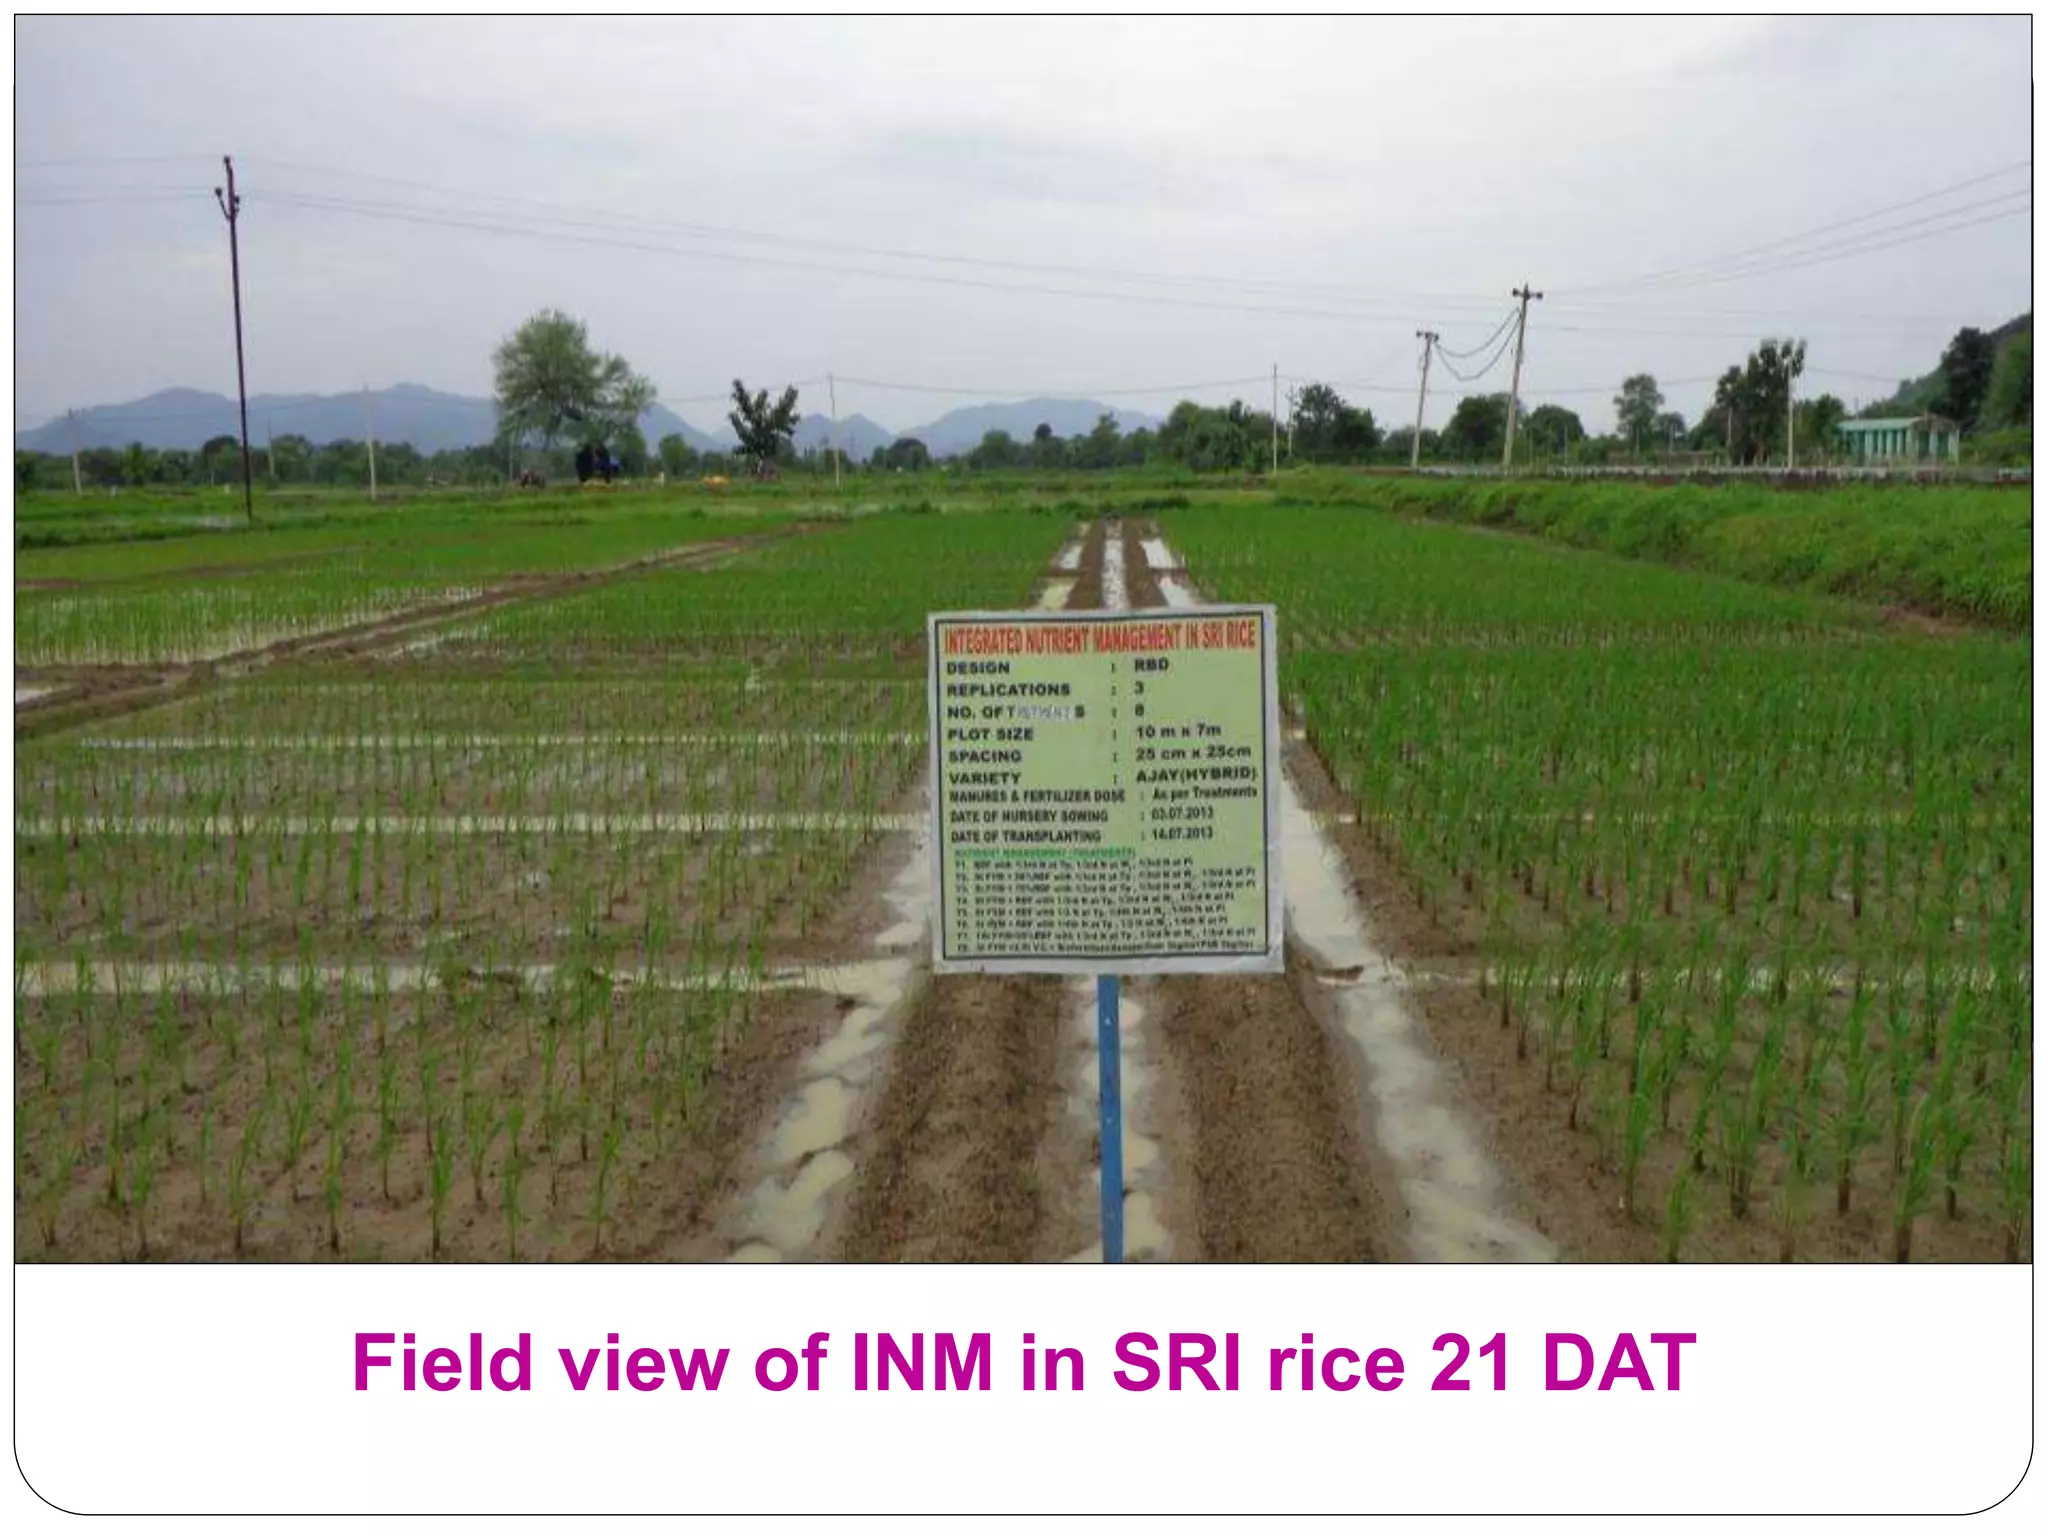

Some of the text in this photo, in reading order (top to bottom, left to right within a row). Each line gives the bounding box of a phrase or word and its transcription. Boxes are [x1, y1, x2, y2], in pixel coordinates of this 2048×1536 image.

[945, 619, 1256, 655] INTEGRATED NUTRIENT MANAGEMENT IN SRI RICE
[947, 661, 1010, 675] DESIGN
[1134, 657, 1170, 672] RBD
[947, 683, 1071, 697] REPLICATIONS
[1135, 681, 1144, 694] 3
[947, 705, 976, 719] NO.
[982, 705, 1004, 718] OF
[1135, 703, 1144, 717] 8
[947, 727, 990, 741] PLOT
[996, 727, 1034, 741] SIZE
[1136, 725, 1155, 739] 10
[1161, 727, 1176, 738] m
[1197, 723, 1222, 737] 7m
[948, 749, 1022, 762] SPACING
[1136, 748, 1155, 762] 25
[1161, 749, 1186, 760] cm
[1192, 748, 1200, 758] x
[1207, 745, 1251, 759] 25cm
[949, 772, 1021, 784] VARIETY
[1136, 766, 1256, 784] AJAY(HYBRID)
[949, 789, 1007, 802] MANURES
[1011, 790, 1019, 802] &
[1023, 789, 1091, 802] FERTILIZER
[1094, 789, 1126, 803] DOSE
[1153, 788, 1167, 800] As
[1171, 789, 1189, 802] per
[1193, 786, 1258, 799] Treatments
[951, 810, 980, 823] DATE
[983, 810, 999, 822] OF
[1002, 810, 1057, 822] NURSERY
[1061, 809, 1109, 822] SOWING
[951, 830, 980, 843] DATE
[983, 830, 999, 842] OF
[1003, 830, 1102, 843] TRANSPLANTING
